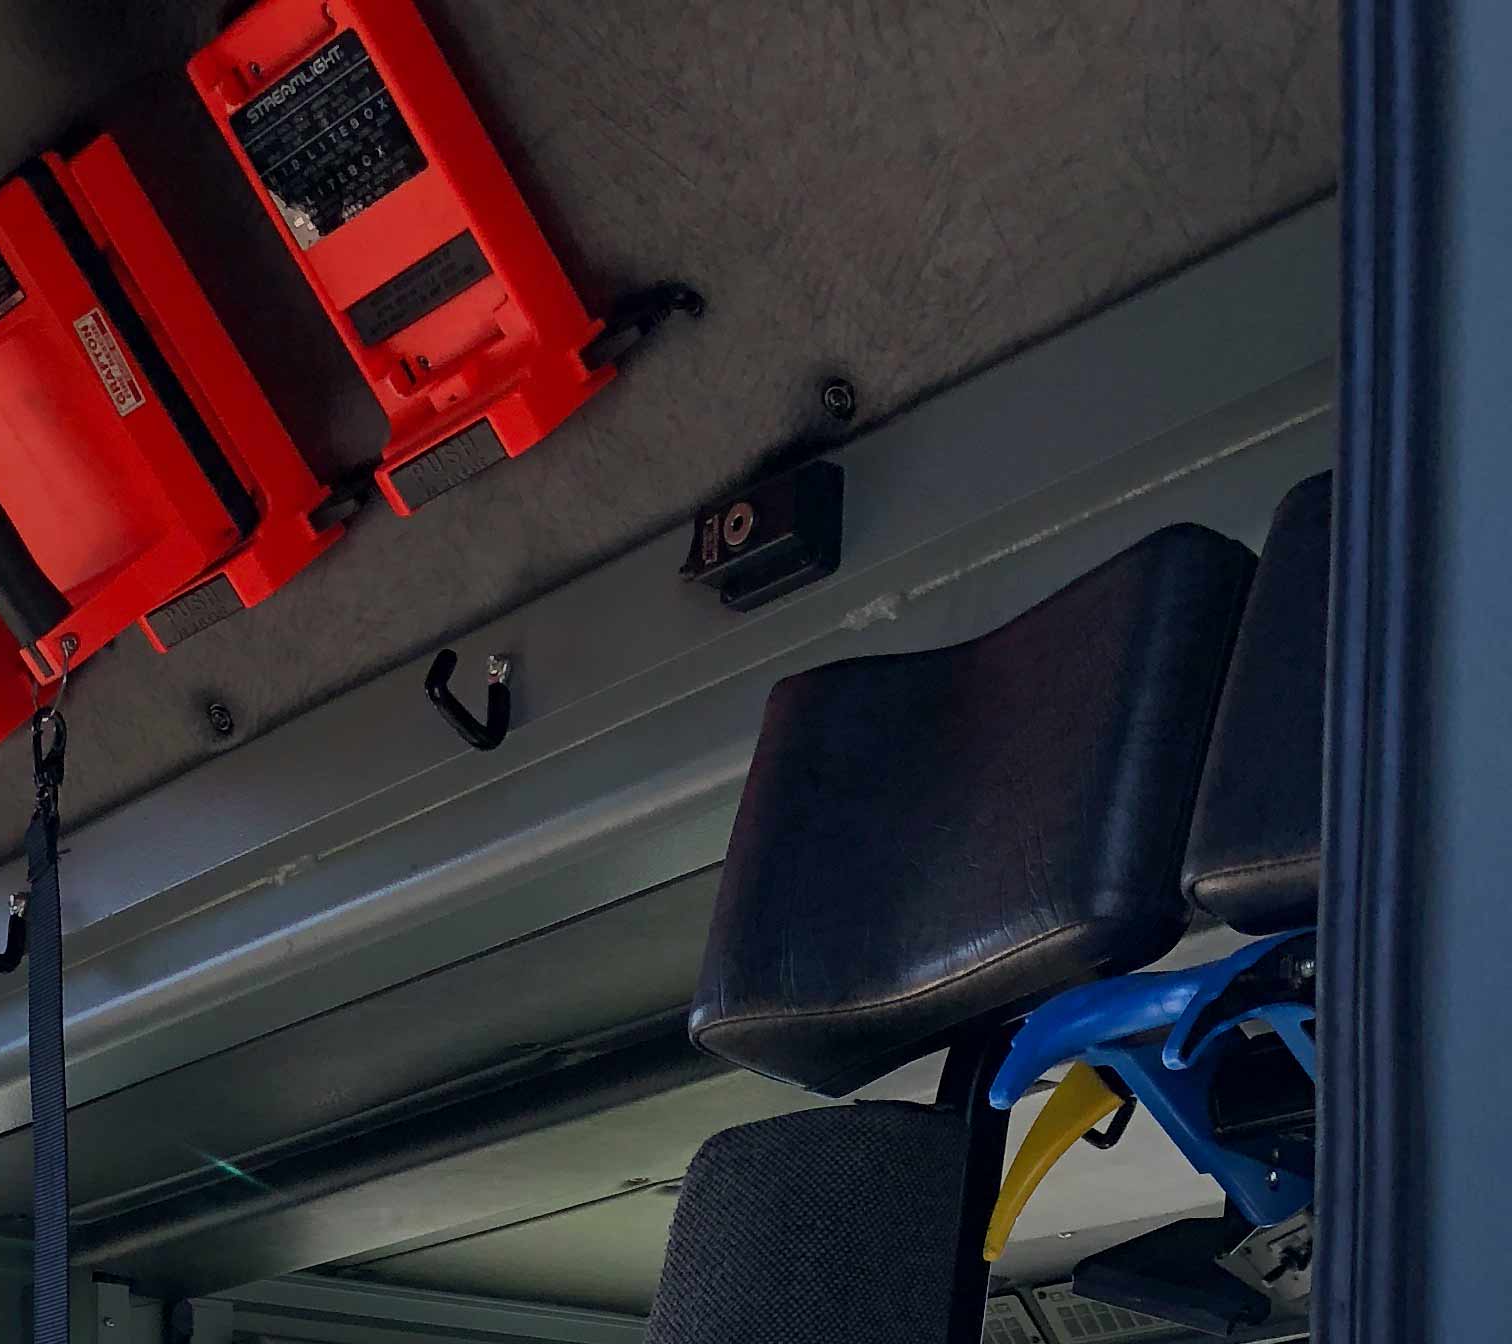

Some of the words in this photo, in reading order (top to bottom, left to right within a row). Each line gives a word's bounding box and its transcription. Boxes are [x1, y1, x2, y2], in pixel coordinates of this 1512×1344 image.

[246, 44, 342, 124] STREAMLIGHT
[411, 431, 476, 487] PUSH
[165, 585, 218, 625] PUSH
